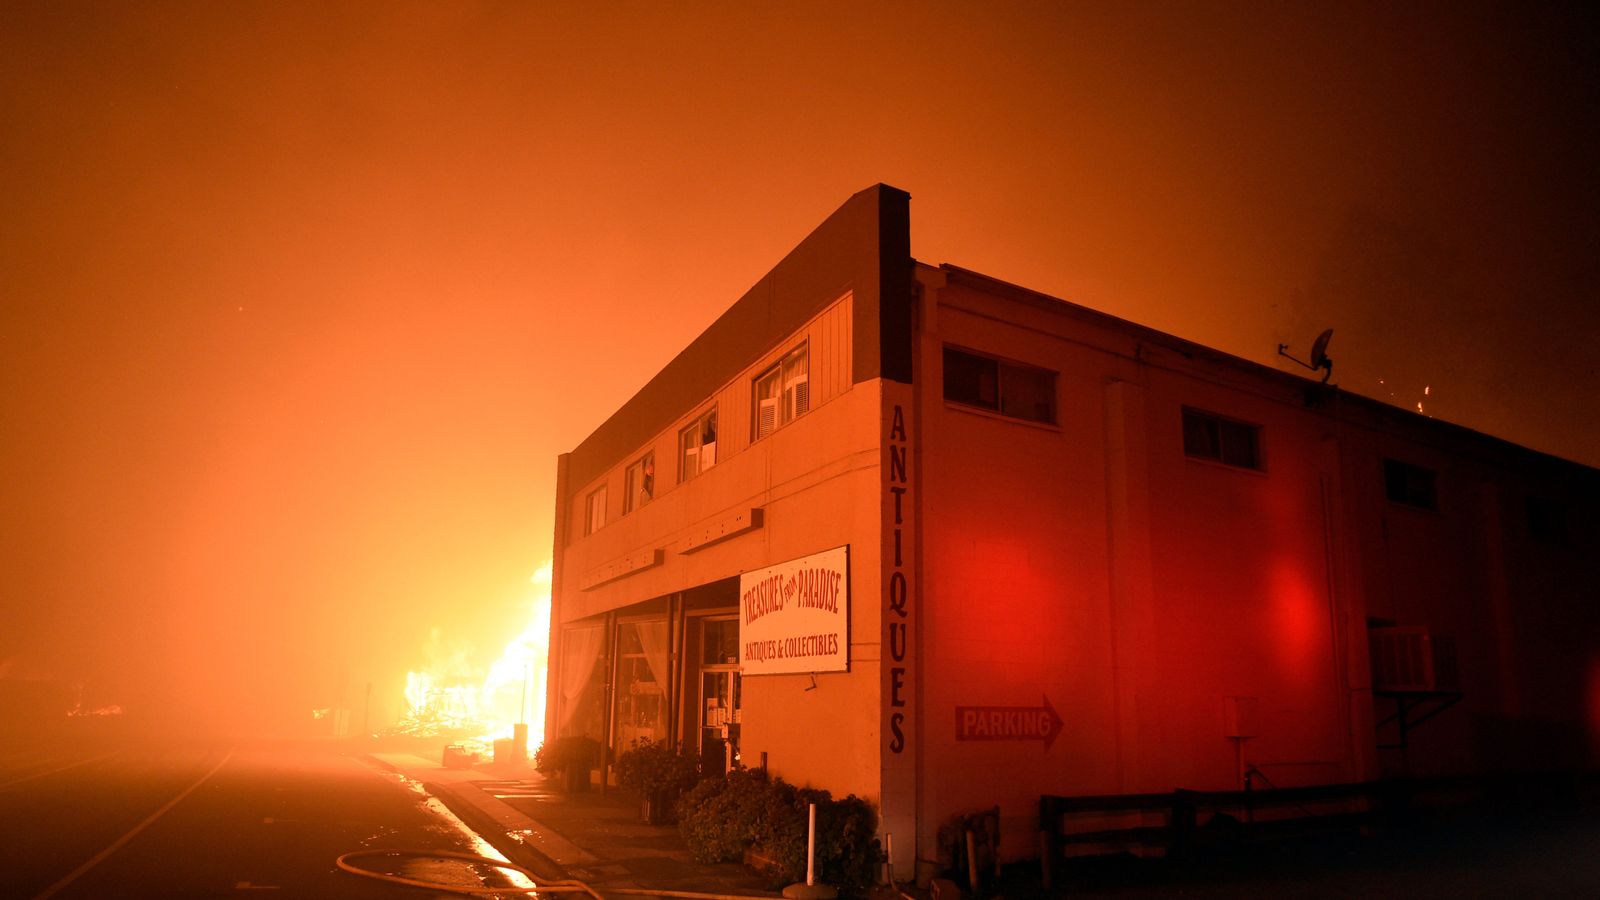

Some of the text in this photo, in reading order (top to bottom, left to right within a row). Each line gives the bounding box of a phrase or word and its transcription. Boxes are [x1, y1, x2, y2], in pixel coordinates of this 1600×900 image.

[744, 568, 841, 625] TREASURES FROM PARADISE
[889, 405, 907, 754] ANTIQUES
[745, 633, 838, 663] ANTIQUES & COLLECTIBLES
[964, 711, 1051, 736] PARKING
